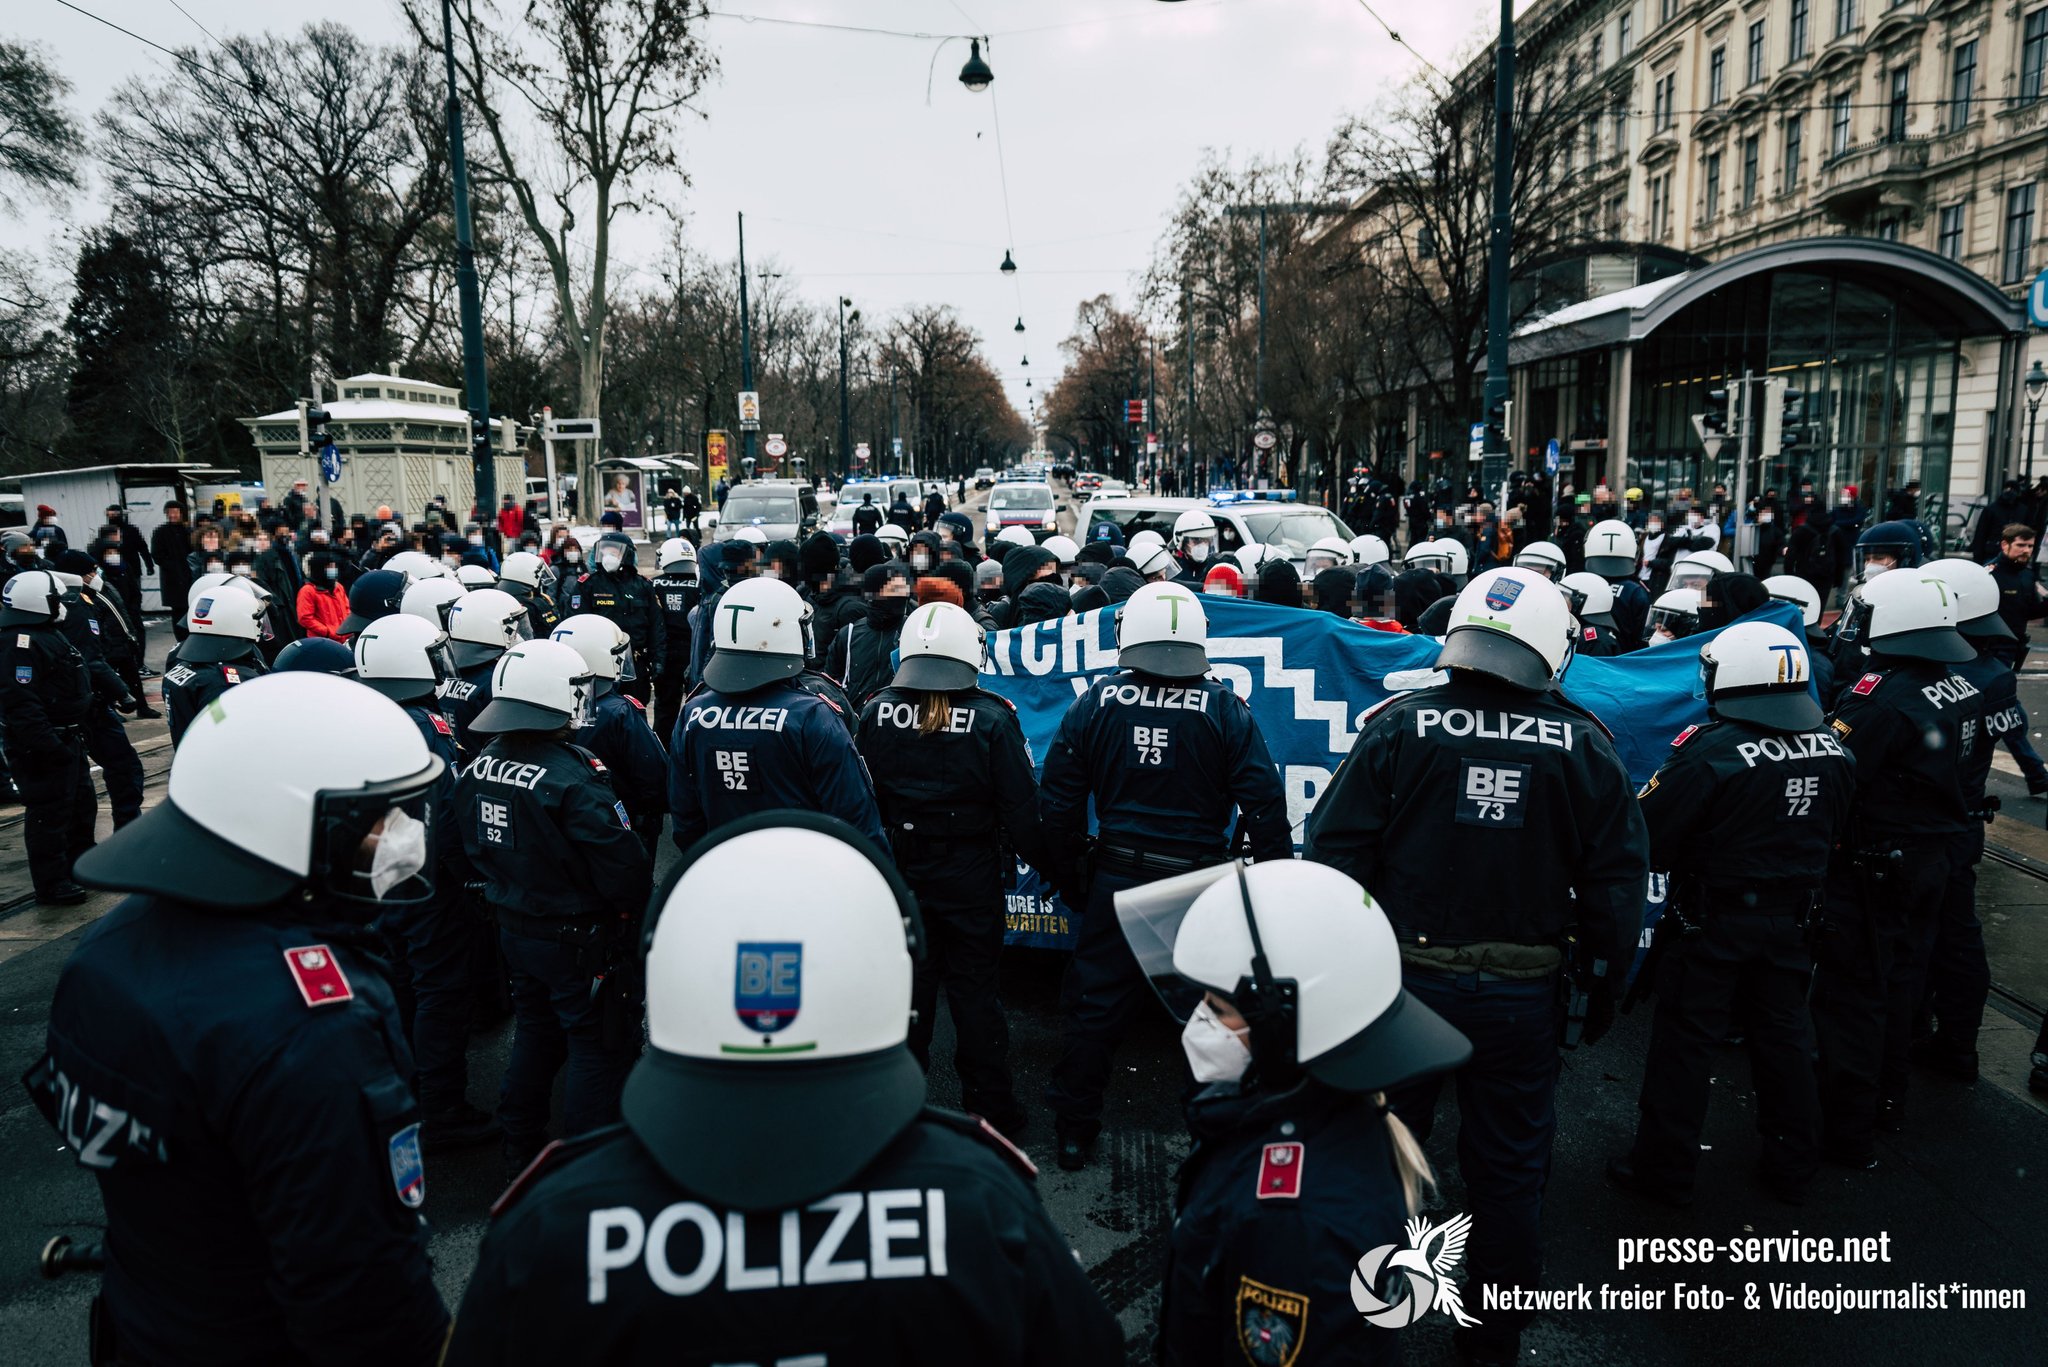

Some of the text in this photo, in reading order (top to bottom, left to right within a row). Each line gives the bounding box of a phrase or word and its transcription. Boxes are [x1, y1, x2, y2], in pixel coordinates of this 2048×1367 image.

[666, 594, 682, 603] BE
[1491, 580, 1521, 601] BE
[1100, 684, 1209, 713] POLIZEI
[1921, 675, 1979, 709] POLIZE
[686, 706, 789, 732] POLIZEI
[1417, 708, 1573, 751] POLIZEI
[1133, 726, 1169, 748] BE
[1962, 720, 1976, 741] BE
[716, 750, 749, 771] BE
[1137, 747, 1162, 765] 73
[461, 755, 547, 790] POLIZEI
[723, 771, 748, 790] 52
[1466, 766, 1521, 798] BE
[1785, 776, 1819, 797] BE
[481, 801, 508, 827] BE
[1476, 801, 1506, 821] 73
[1787, 797, 1811, 816] 72
[487, 828, 502, 843] 52
[740, 952, 800, 996] BE
[588, 1189, 948, 1304] POLIZEI
[1242, 1286, 1300, 1317] POLIZEI
